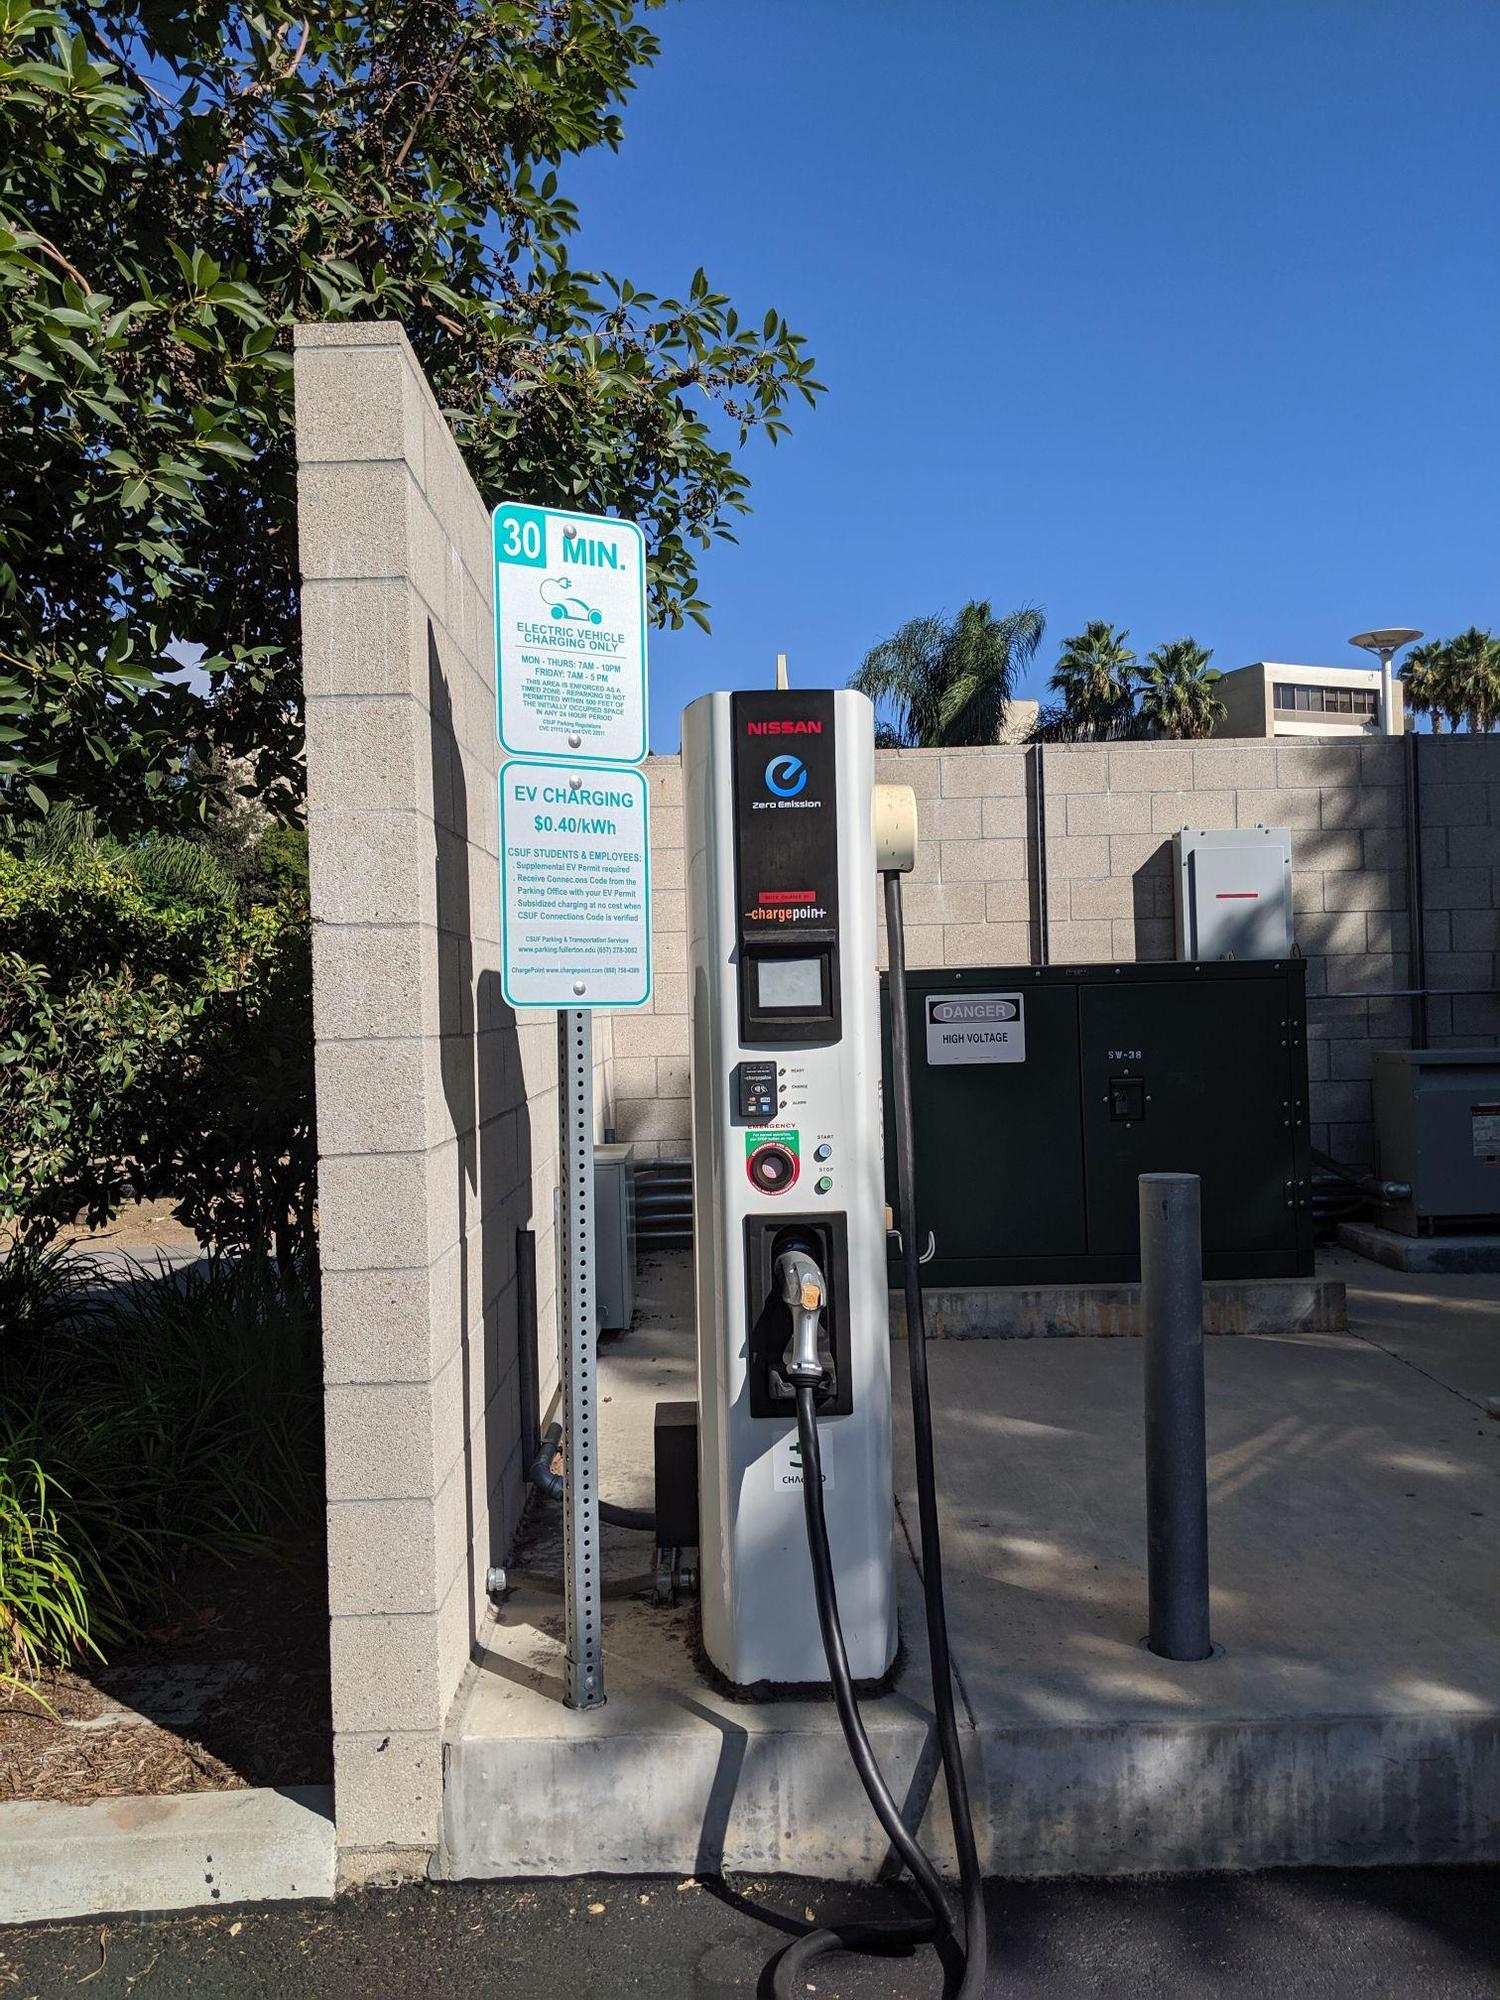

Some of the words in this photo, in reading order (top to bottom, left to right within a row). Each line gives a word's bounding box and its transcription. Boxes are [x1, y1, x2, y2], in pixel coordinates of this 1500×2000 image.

[503, 517, 541, 560] 30
[562, 535, 626, 571] MIN.
[517, 622, 573, 637] ELECTRIC
[577, 629, 625, 643] VEHICLE
[524, 633, 585, 649] CHARGING
[589, 641, 618, 652] ONLY
[521, 655, 540, 664] MON
[547, 658, 576, 668] THURS:
[578, 661, 594, 670] 7AM
[602, 664, 621, 673] 10PM
[535, 667, 565, 678] FRIDAY:
[567, 670, 584, 680] 7AM
[590, 673, 594, 681] 5
[597, 673, 608, 682] PM
[570, 683, 604, 692] ENFORCED
[523, 693, 560, 702] PERMITTED
[566, 690, 604, 699] REPARKING
[537, 701, 567, 710] INITIALLY
[569, 704, 602, 713] OCCUPIED
[604, 707, 624, 715] SPACE
[589, 713, 612, 721] PERIOD
[747, 720, 822, 735] NISSAN
[514, 785, 538, 802] EV
[543, 787, 634, 808] CHARGING
[752, 801, 777, 809] Zero
[778, 800, 821, 809] Emission
[534, 814, 617, 835] $0.40/kWh
[508, 847, 531, 857] CSUF
[533, 848, 579, 859] STUDENTS
[581, 850, 587, 859] &
[516, 861, 564, 870] Supplemental
[566, 863, 577, 871] EV
[602, 866, 630, 874] required
[517, 874, 545, 882] Receive
[609, 877, 624, 885] from
[517, 886, 545, 896] Parking
[546, 887, 568, 895] Office
[569, 888, 584, 896] with
[585, 890, 601, 898] your
[603, 889, 612, 897] EV
[614, 890, 636, 898] Permit
[517, 899, 556, 908] Subsidized
[558, 900, 588, 910] charging
[517, 911, 538, 920] CSUF
[540, 912, 584, 920] Connections
[542, 936, 562, 944] Parking
[943, 1005, 1006, 1019] DANGER
[942, 1034, 964, 1044] HIGH
[966, 1032, 1008, 1043] VOLTAGE
[1108, 1050, 1142, 1059] SW-38
